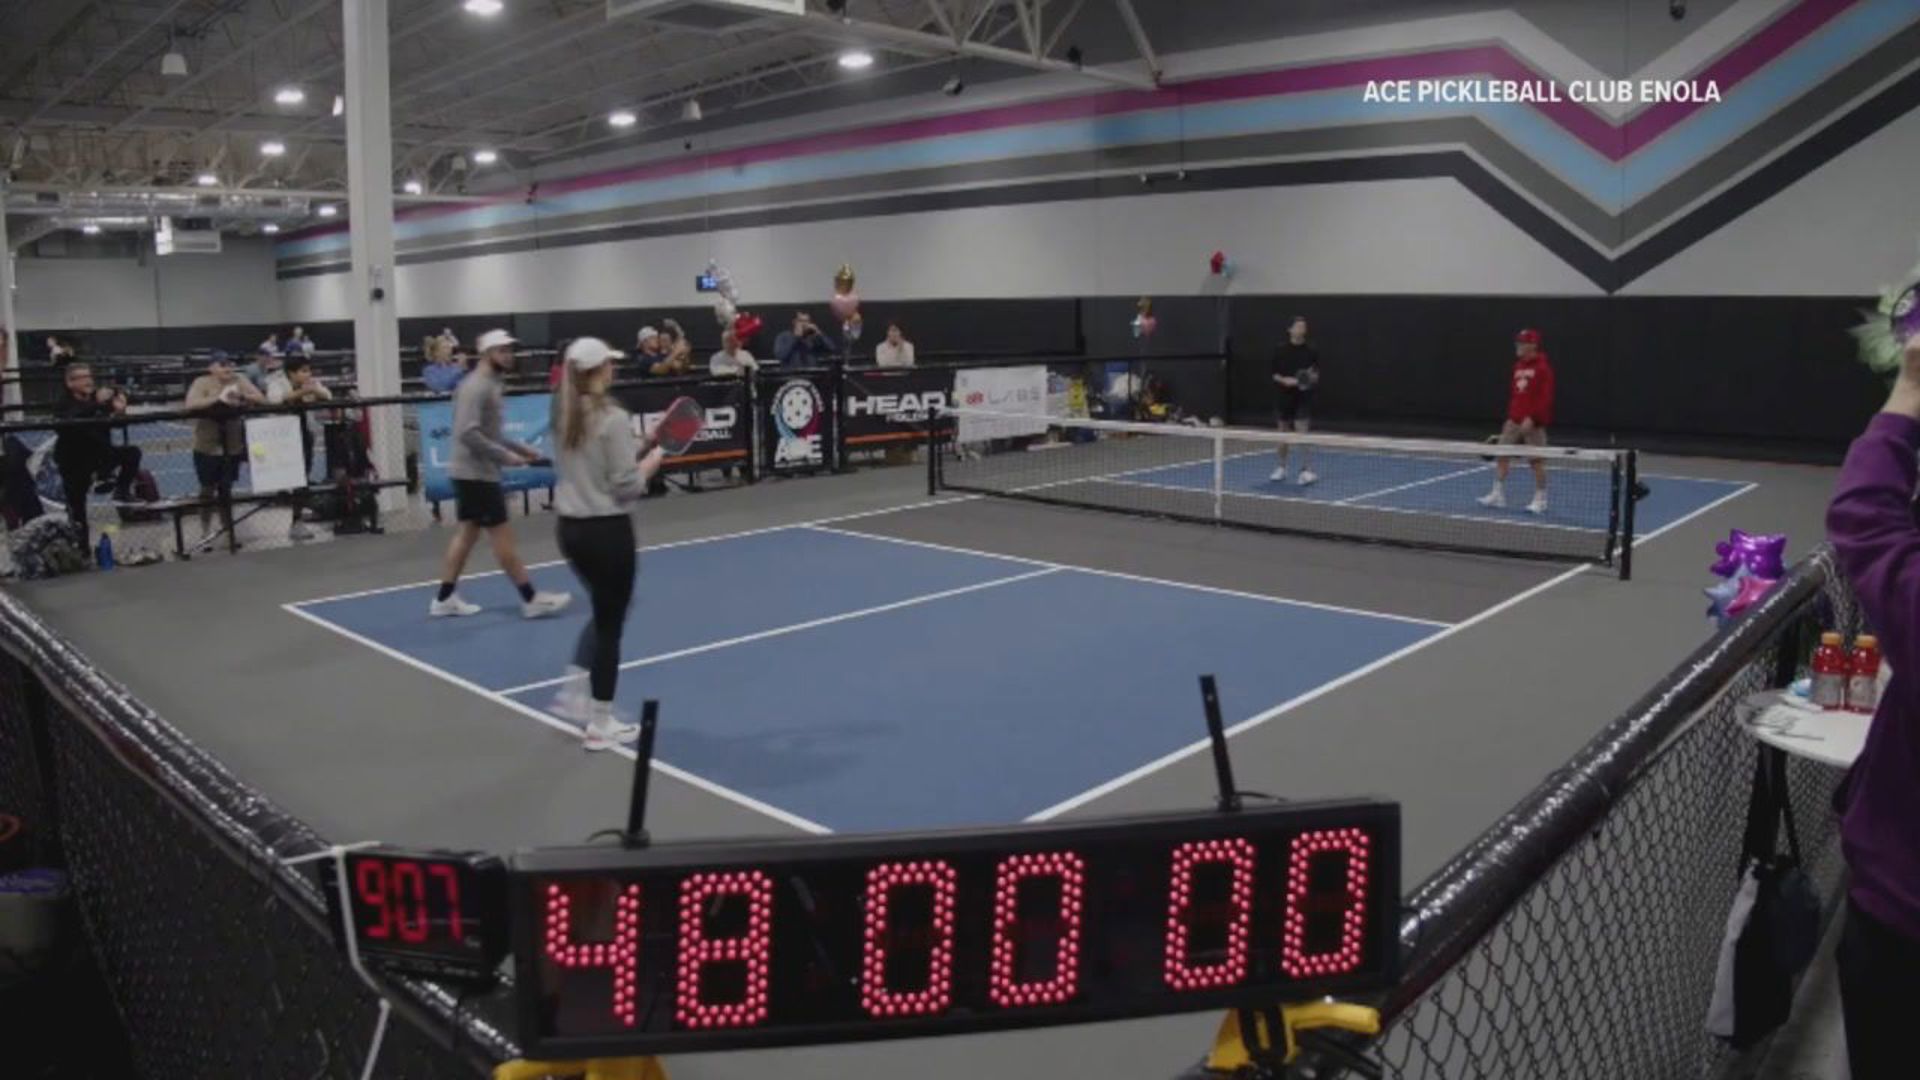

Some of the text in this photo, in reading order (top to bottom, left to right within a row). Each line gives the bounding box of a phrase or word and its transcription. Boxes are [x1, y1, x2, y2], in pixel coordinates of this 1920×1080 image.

[545, 826, 1370, 1028] 48 00 00
